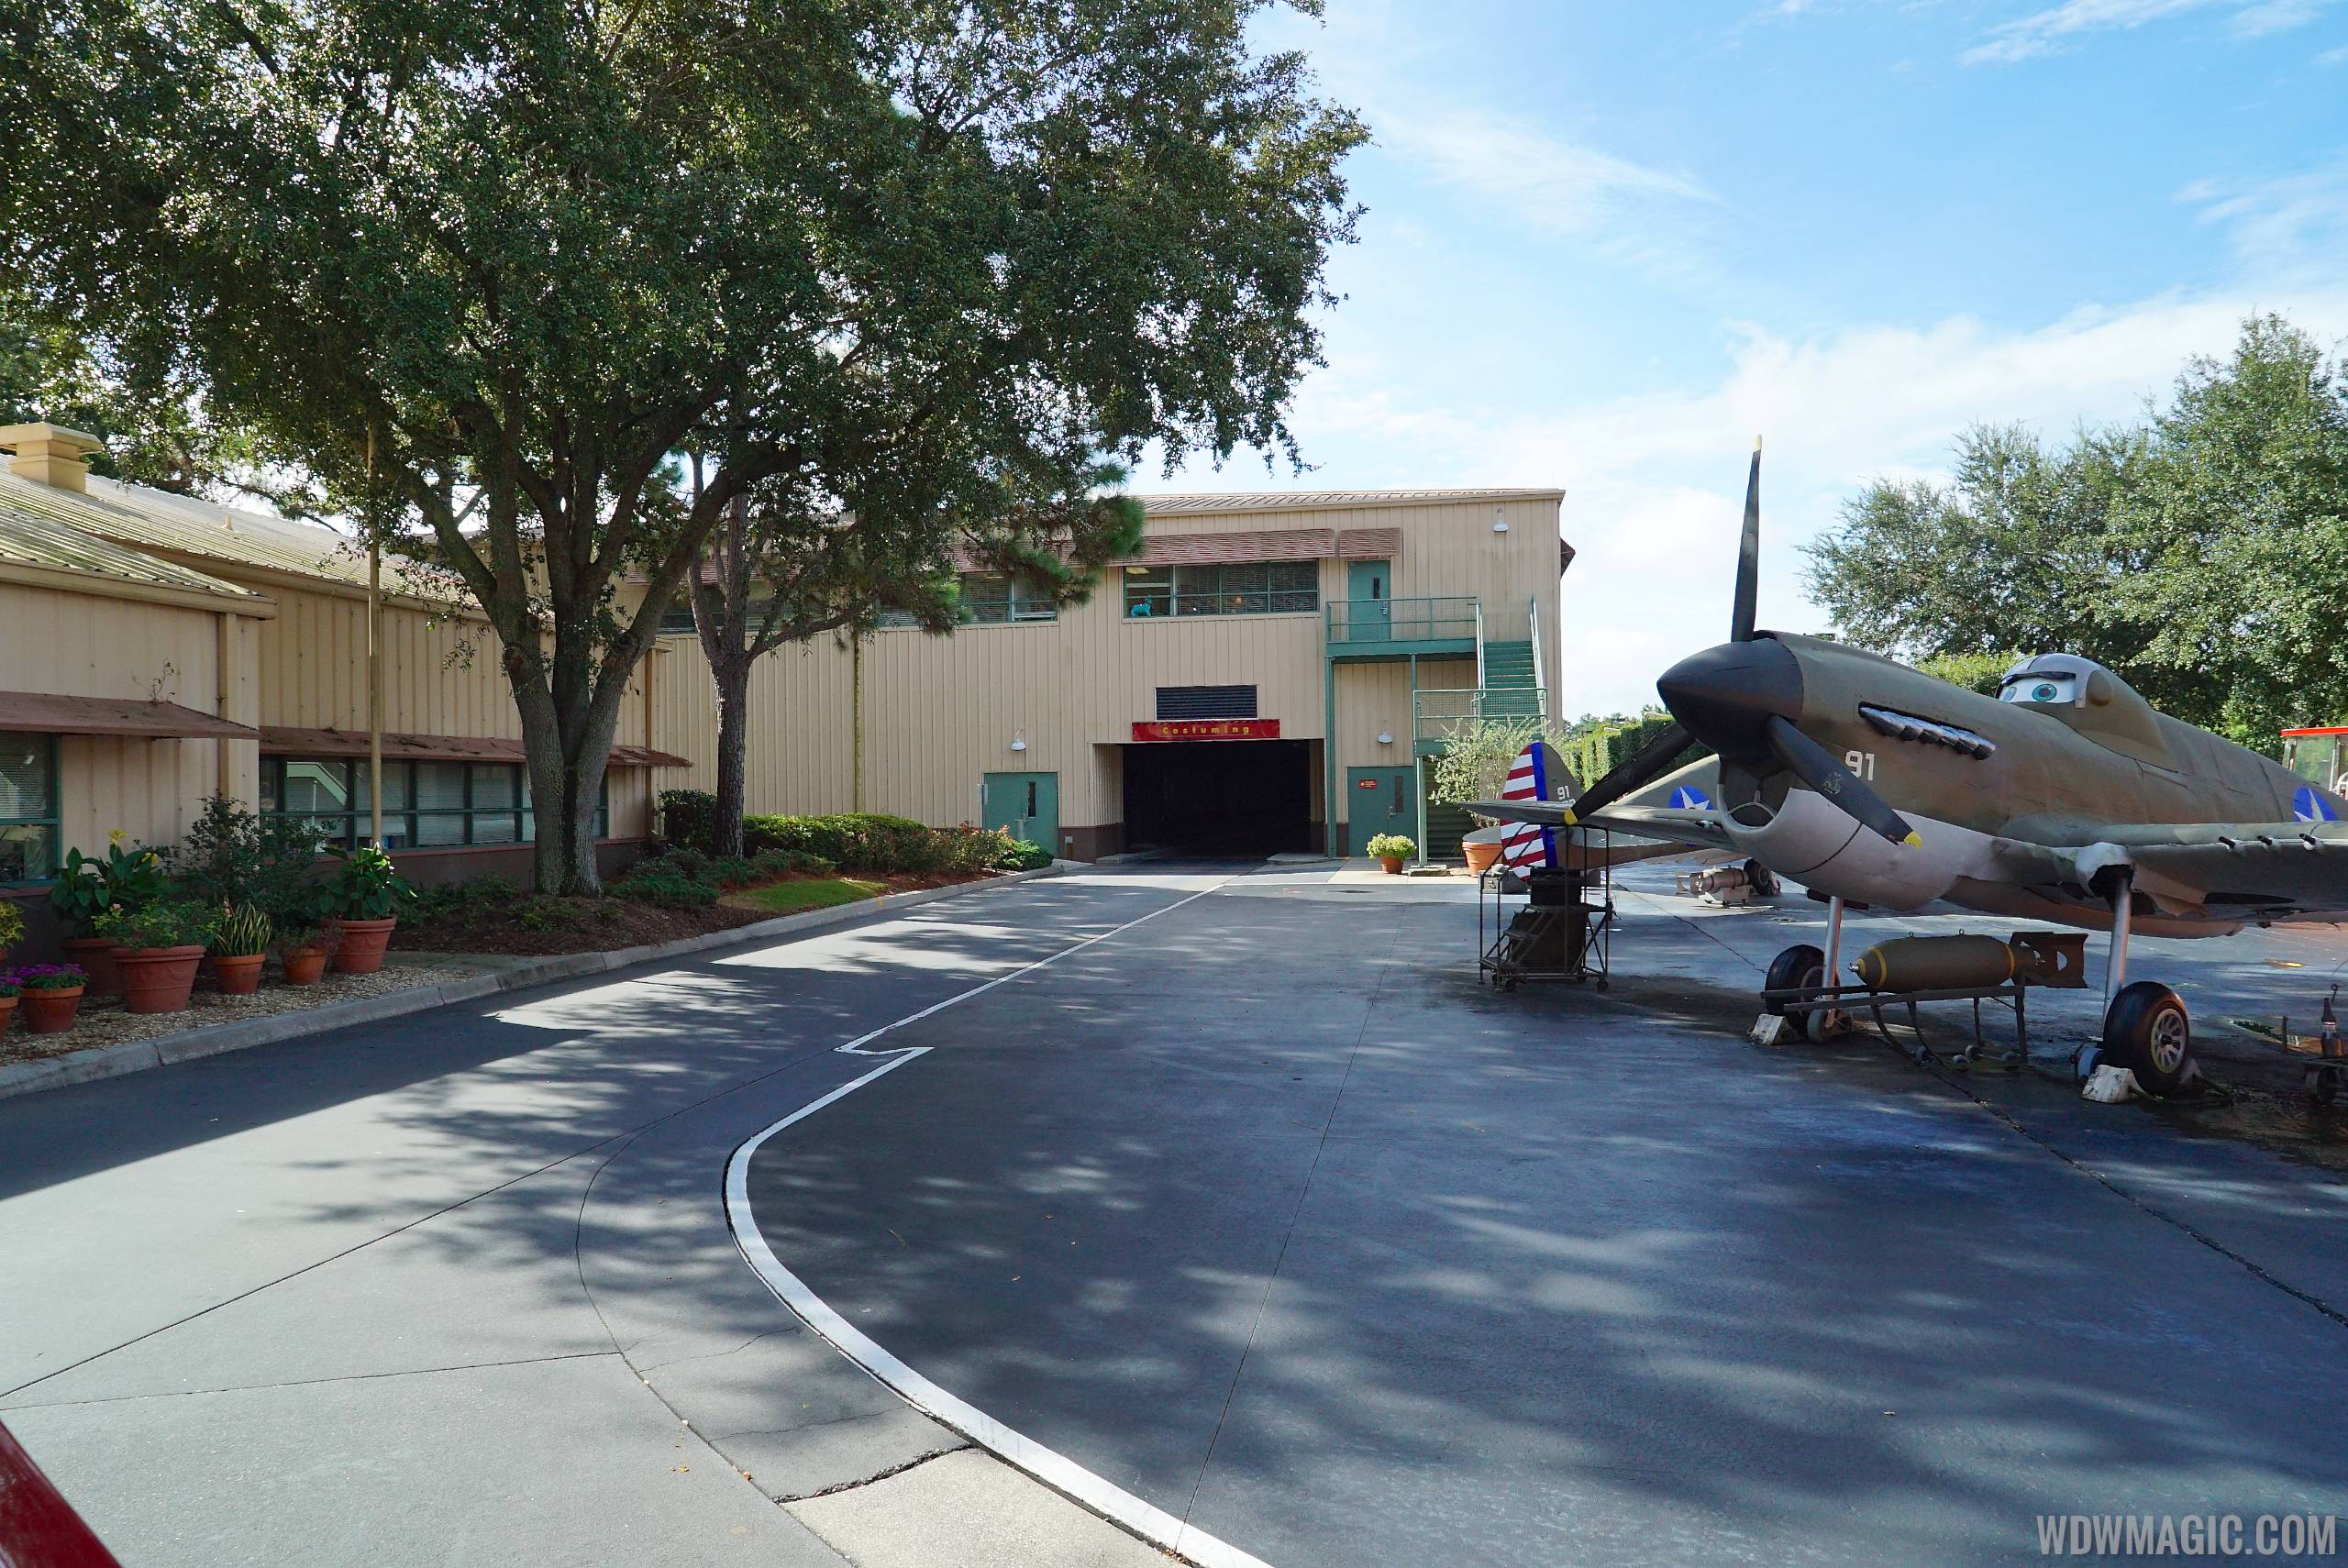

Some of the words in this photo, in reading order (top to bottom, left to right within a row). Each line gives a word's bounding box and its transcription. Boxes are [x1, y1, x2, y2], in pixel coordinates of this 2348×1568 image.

[1162, 725, 1249, 734] Costuming
[1845, 750, 1875, 780] 91
[1556, 785, 1570, 800] 91
